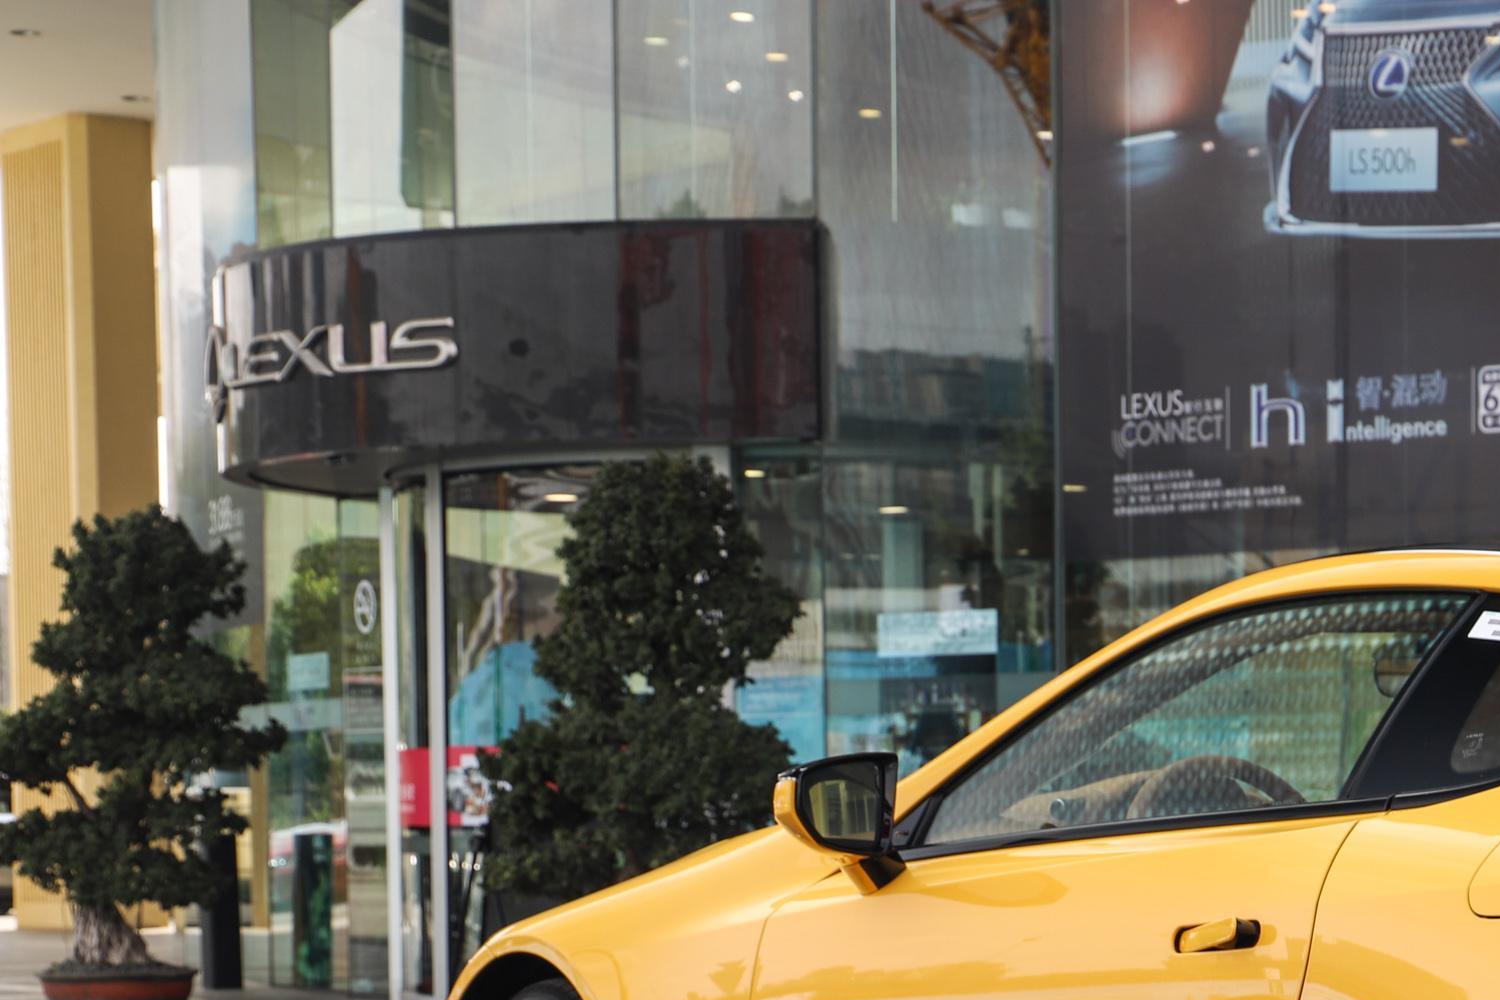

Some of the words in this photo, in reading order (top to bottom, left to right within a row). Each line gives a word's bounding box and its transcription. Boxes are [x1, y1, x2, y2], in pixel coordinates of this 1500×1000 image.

[1348, 148, 1368, 174] LS
[1371, 147, 1416, 173] 500h
[222, 316, 458, 388] LEXUS
[1121, 389, 1184, 420] LEXUS
[1251, 383, 1305, 448] h
[1121, 414, 1223, 448] CONNECT
